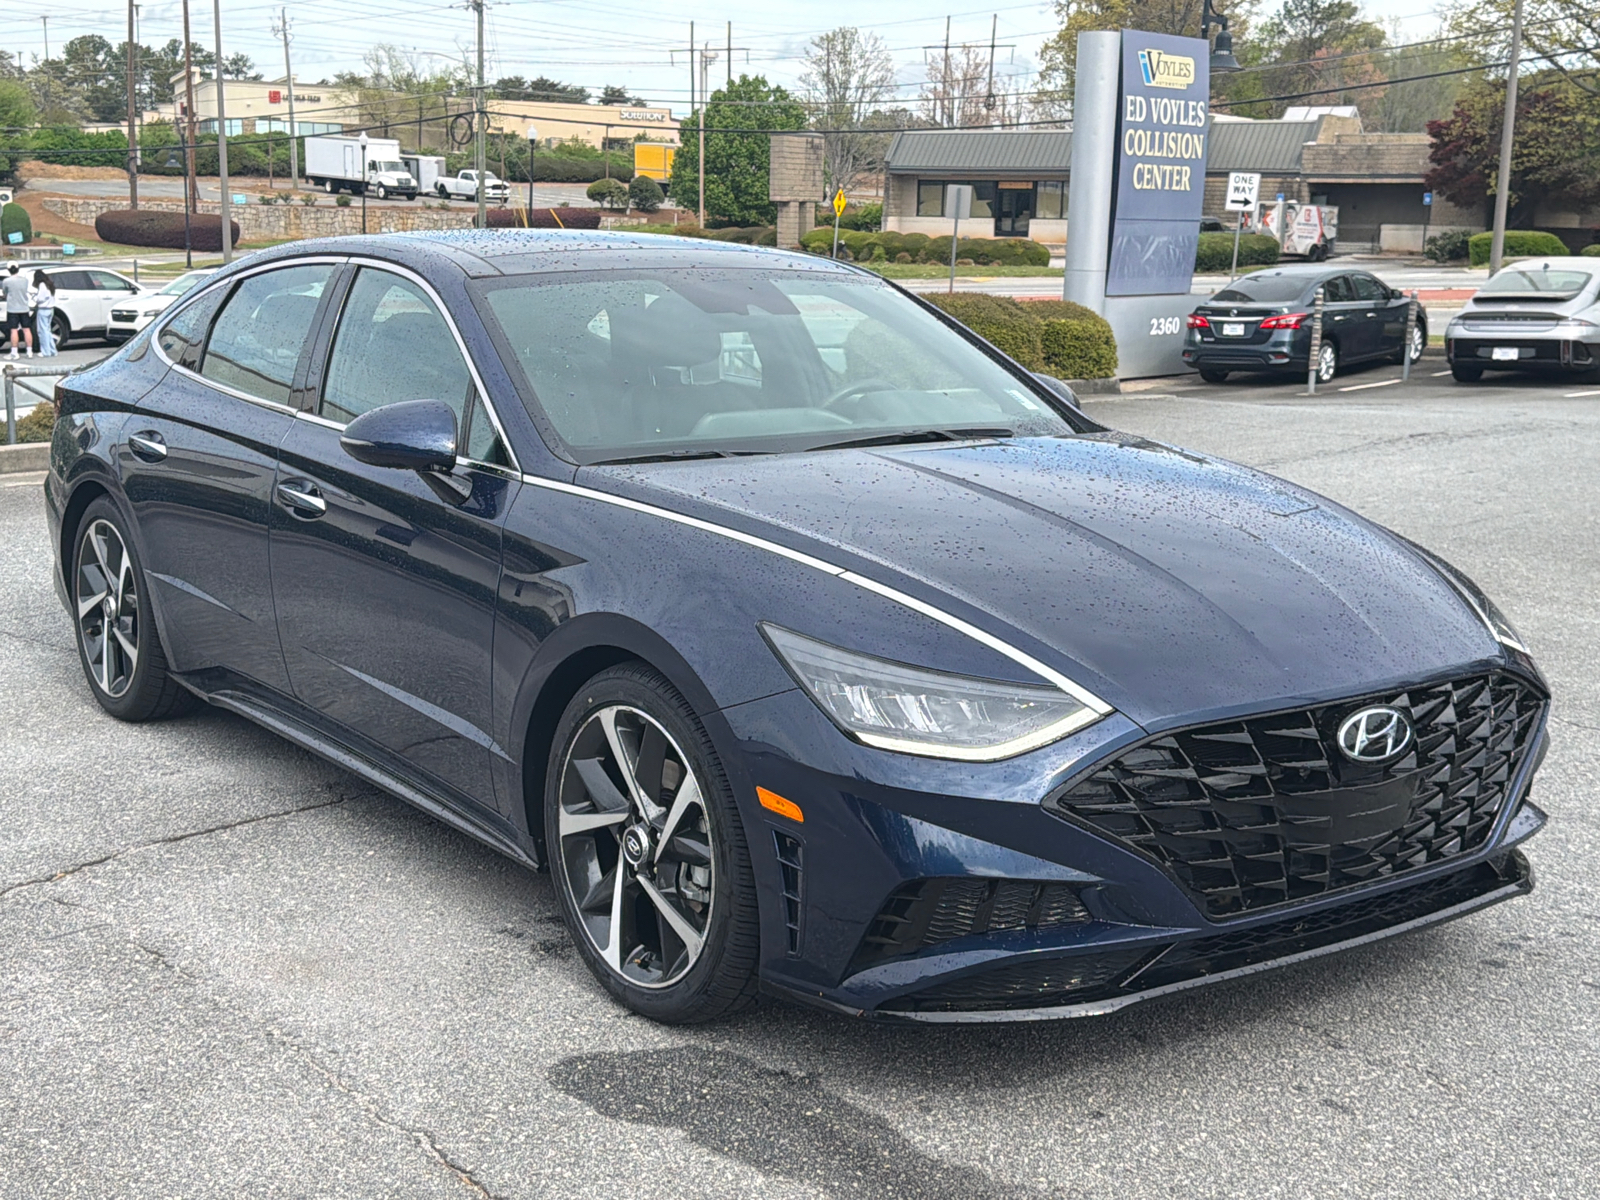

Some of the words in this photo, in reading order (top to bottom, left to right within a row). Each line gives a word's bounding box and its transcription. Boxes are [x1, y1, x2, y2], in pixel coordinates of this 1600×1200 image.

[1147, 51, 1191, 82] VOYLES
[1126, 95, 1147, 122] ED
[1150, 97, 1205, 127] VOYLES
[1124, 128, 1204, 159] COLLISION
[1133, 163, 1191, 191] CENTER
[1233, 185, 1255, 195] WAY
[1234, 175, 1255, 185] ONE
[1149, 316, 1180, 336] 2360
